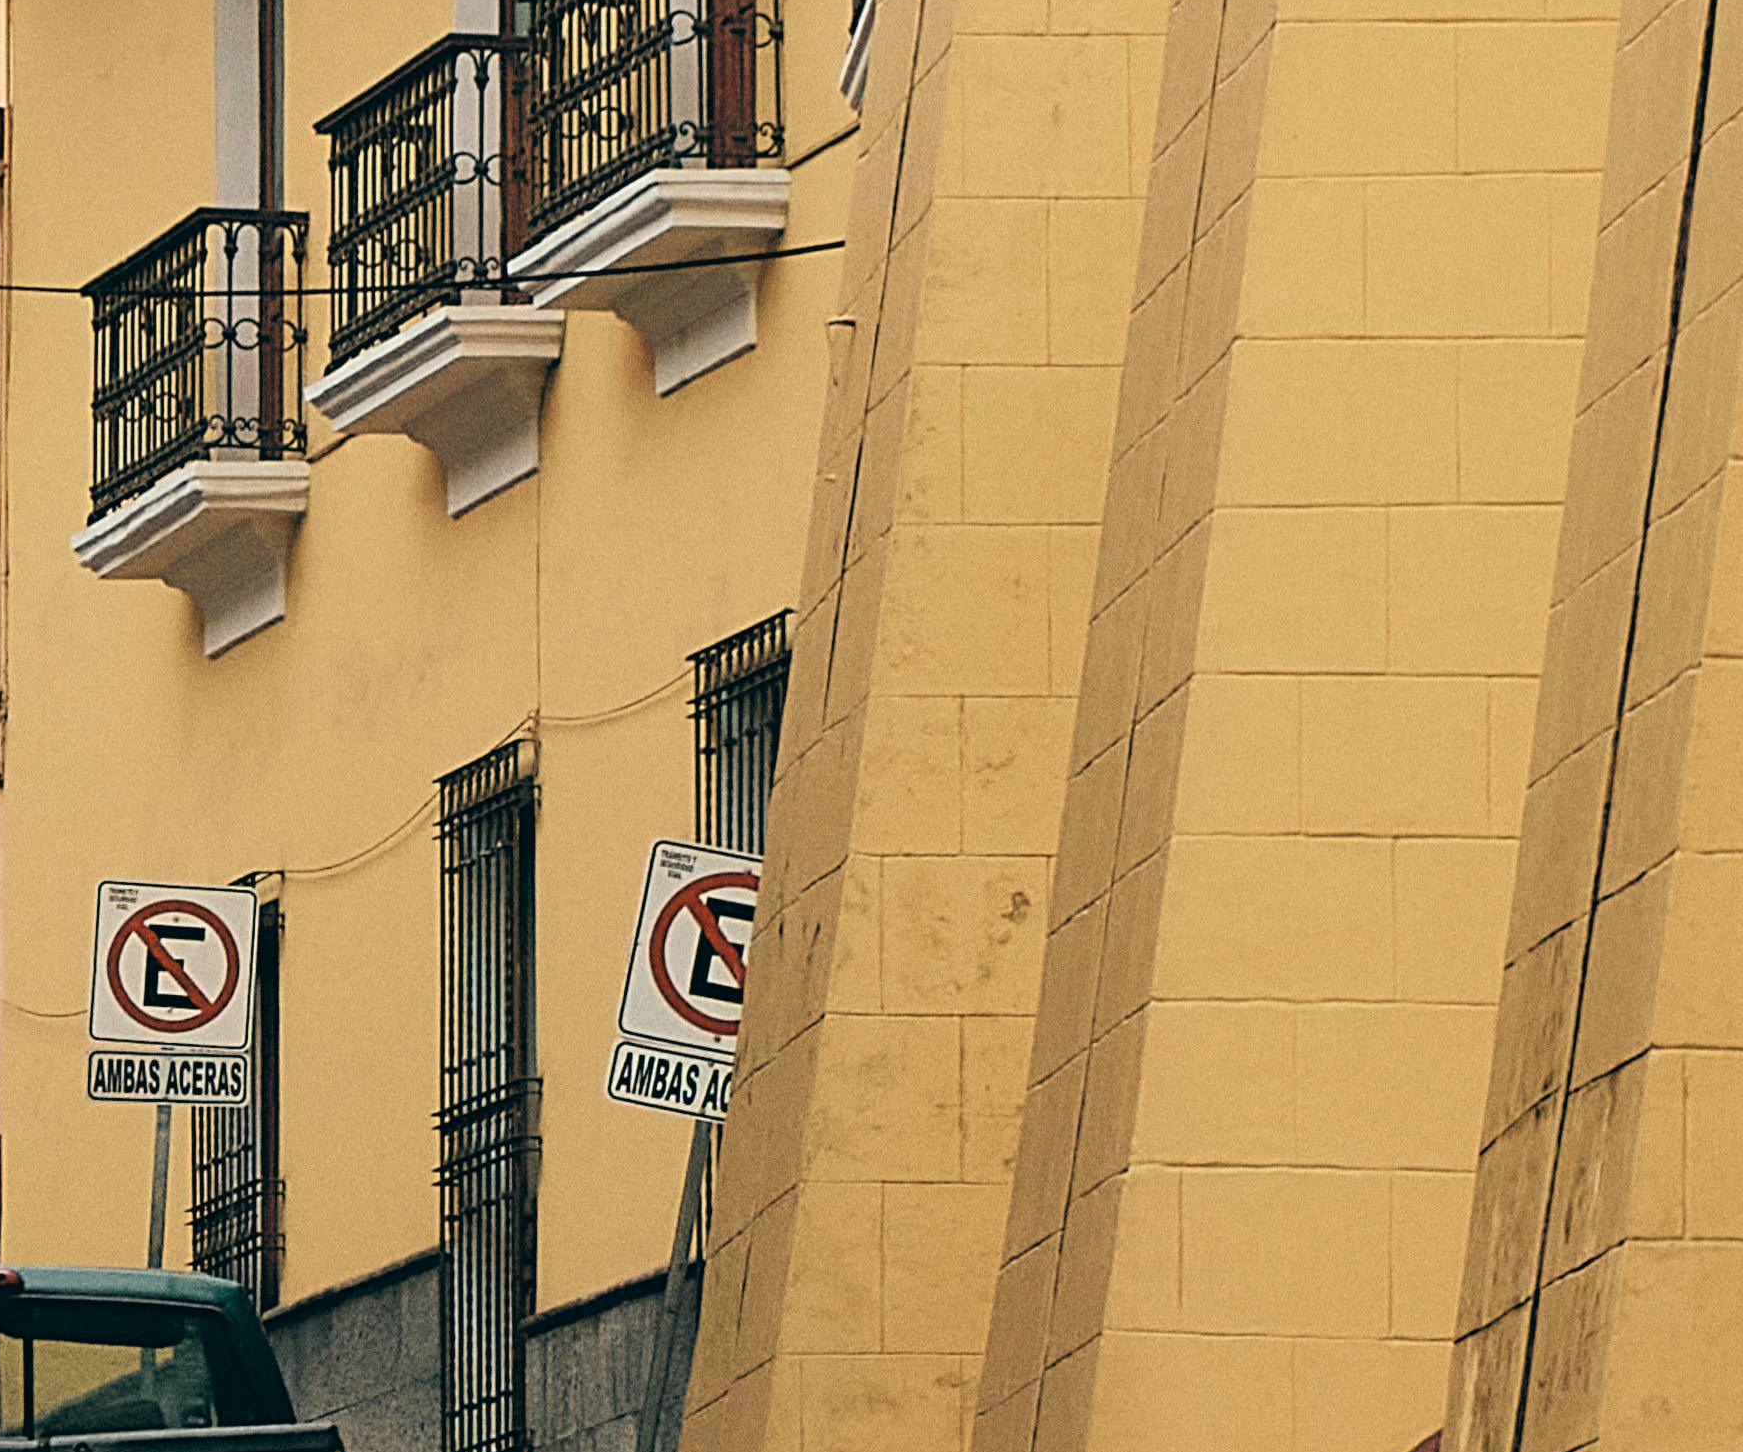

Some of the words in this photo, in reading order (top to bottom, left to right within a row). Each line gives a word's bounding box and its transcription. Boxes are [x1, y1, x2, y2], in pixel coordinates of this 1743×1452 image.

[92, 1058, 160, 1095] AMBAS
[165, 1060, 242, 1097] ACERAS
[615, 1051, 700, 1106] AMBAS
